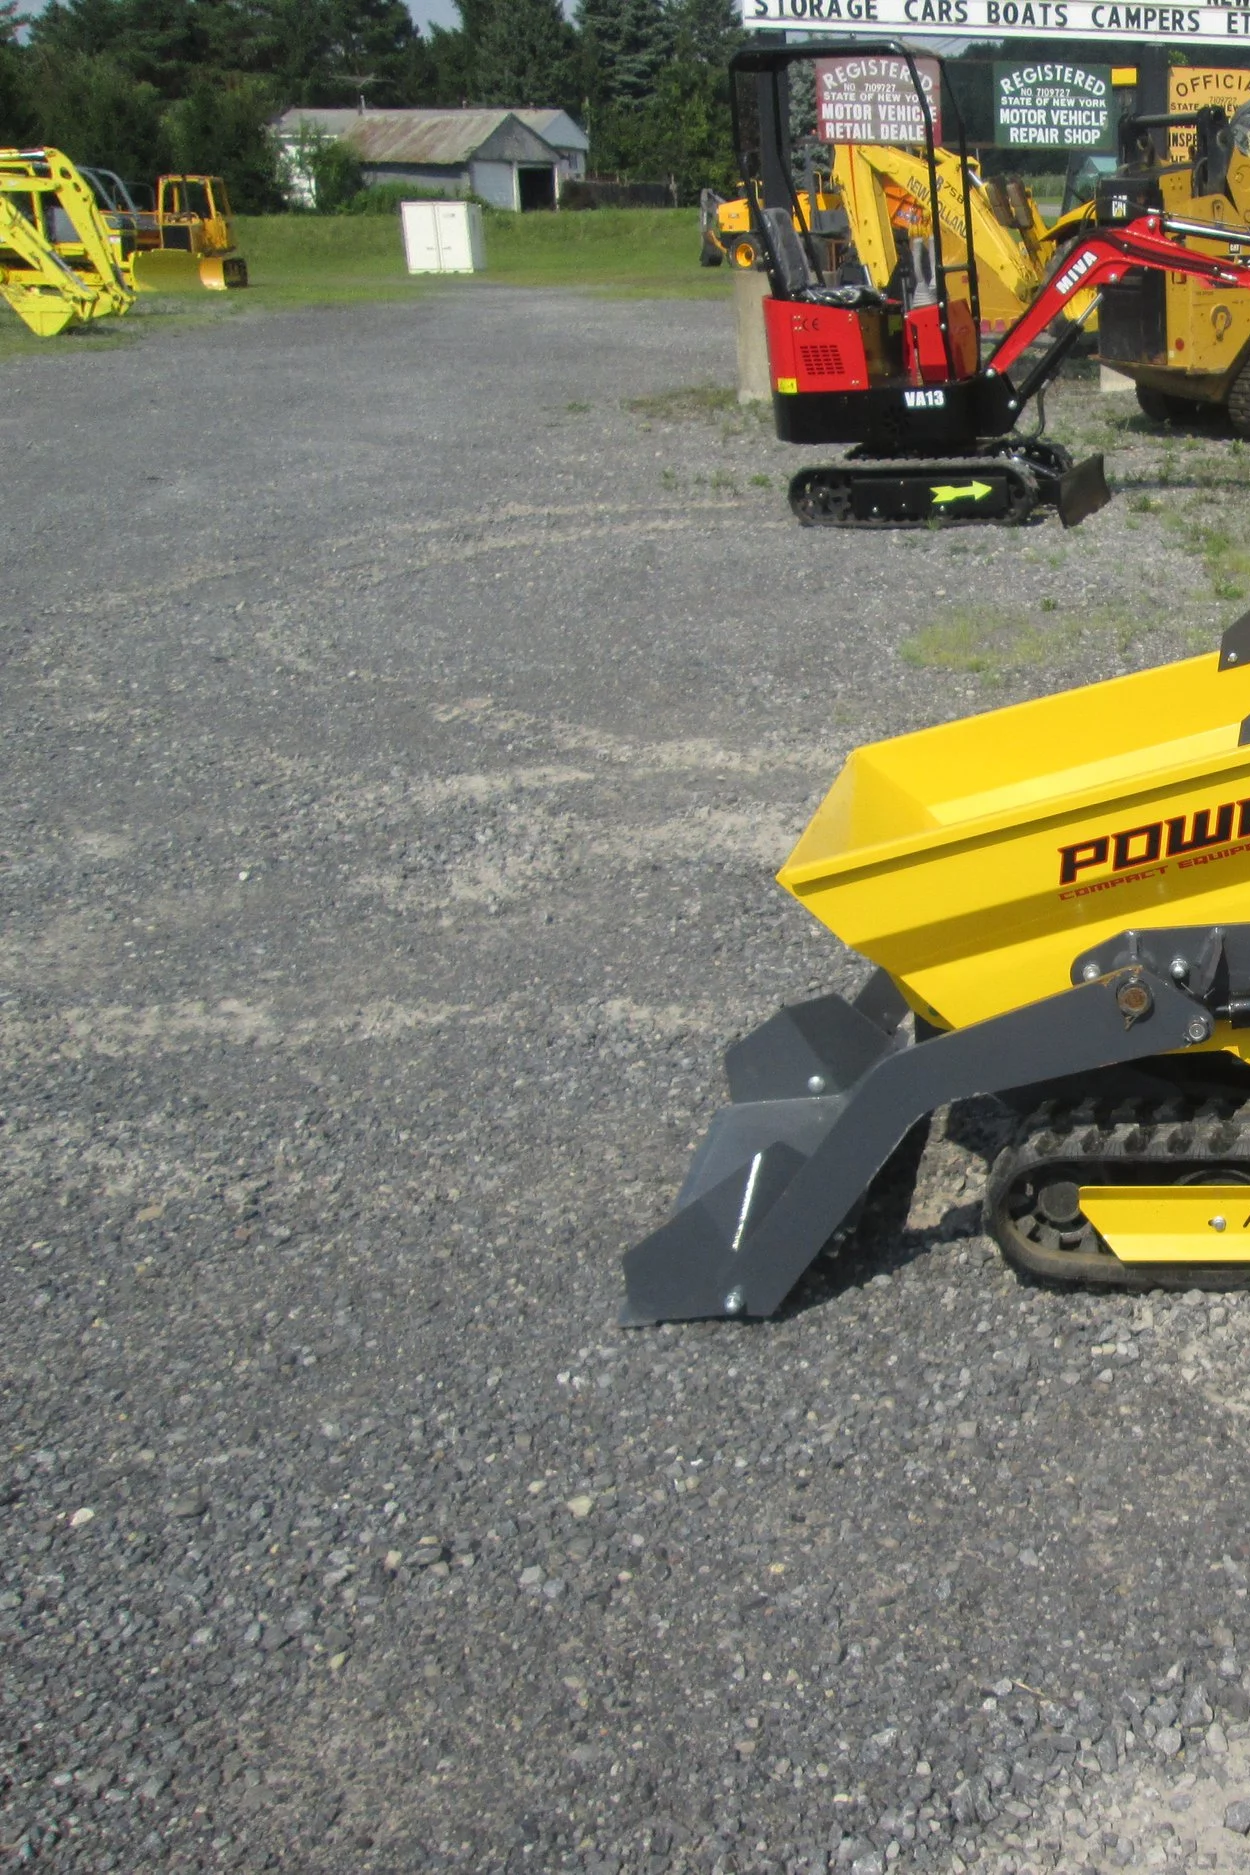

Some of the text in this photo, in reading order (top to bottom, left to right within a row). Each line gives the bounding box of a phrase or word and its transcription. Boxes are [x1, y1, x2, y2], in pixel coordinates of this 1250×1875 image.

[905, 0, 968, 23] CARS
[988, 2, 1068, 28] BOATS
[1091, 4, 1200, 32] CAMPERS
[823, 60, 933, 91] REGISTERD
[1000, 64, 1106, 95] REGISTERED
[823, 91, 934, 104] STATE OF NEW YOK
[1036, 87, 1071, 97] 7109727
[1001, 96, 1106, 108] STATE OF NEW YORK
[1170, 102, 1199, 111] STATE
[822, 103, 937, 122] MOTOR VEHICE
[1000, 108, 1108, 127] MOTOR VEHICLE
[826, 122, 927, 141] RETAIL DEALE
[1009, 127, 1101, 145] REPAIR SHOP
[1229, 243, 1240, 253] CAT
[1055, 250, 1099, 295] MIVA
[904, 390, 945, 407] VA13
[1059, 865, 1169, 902] COMPACT
